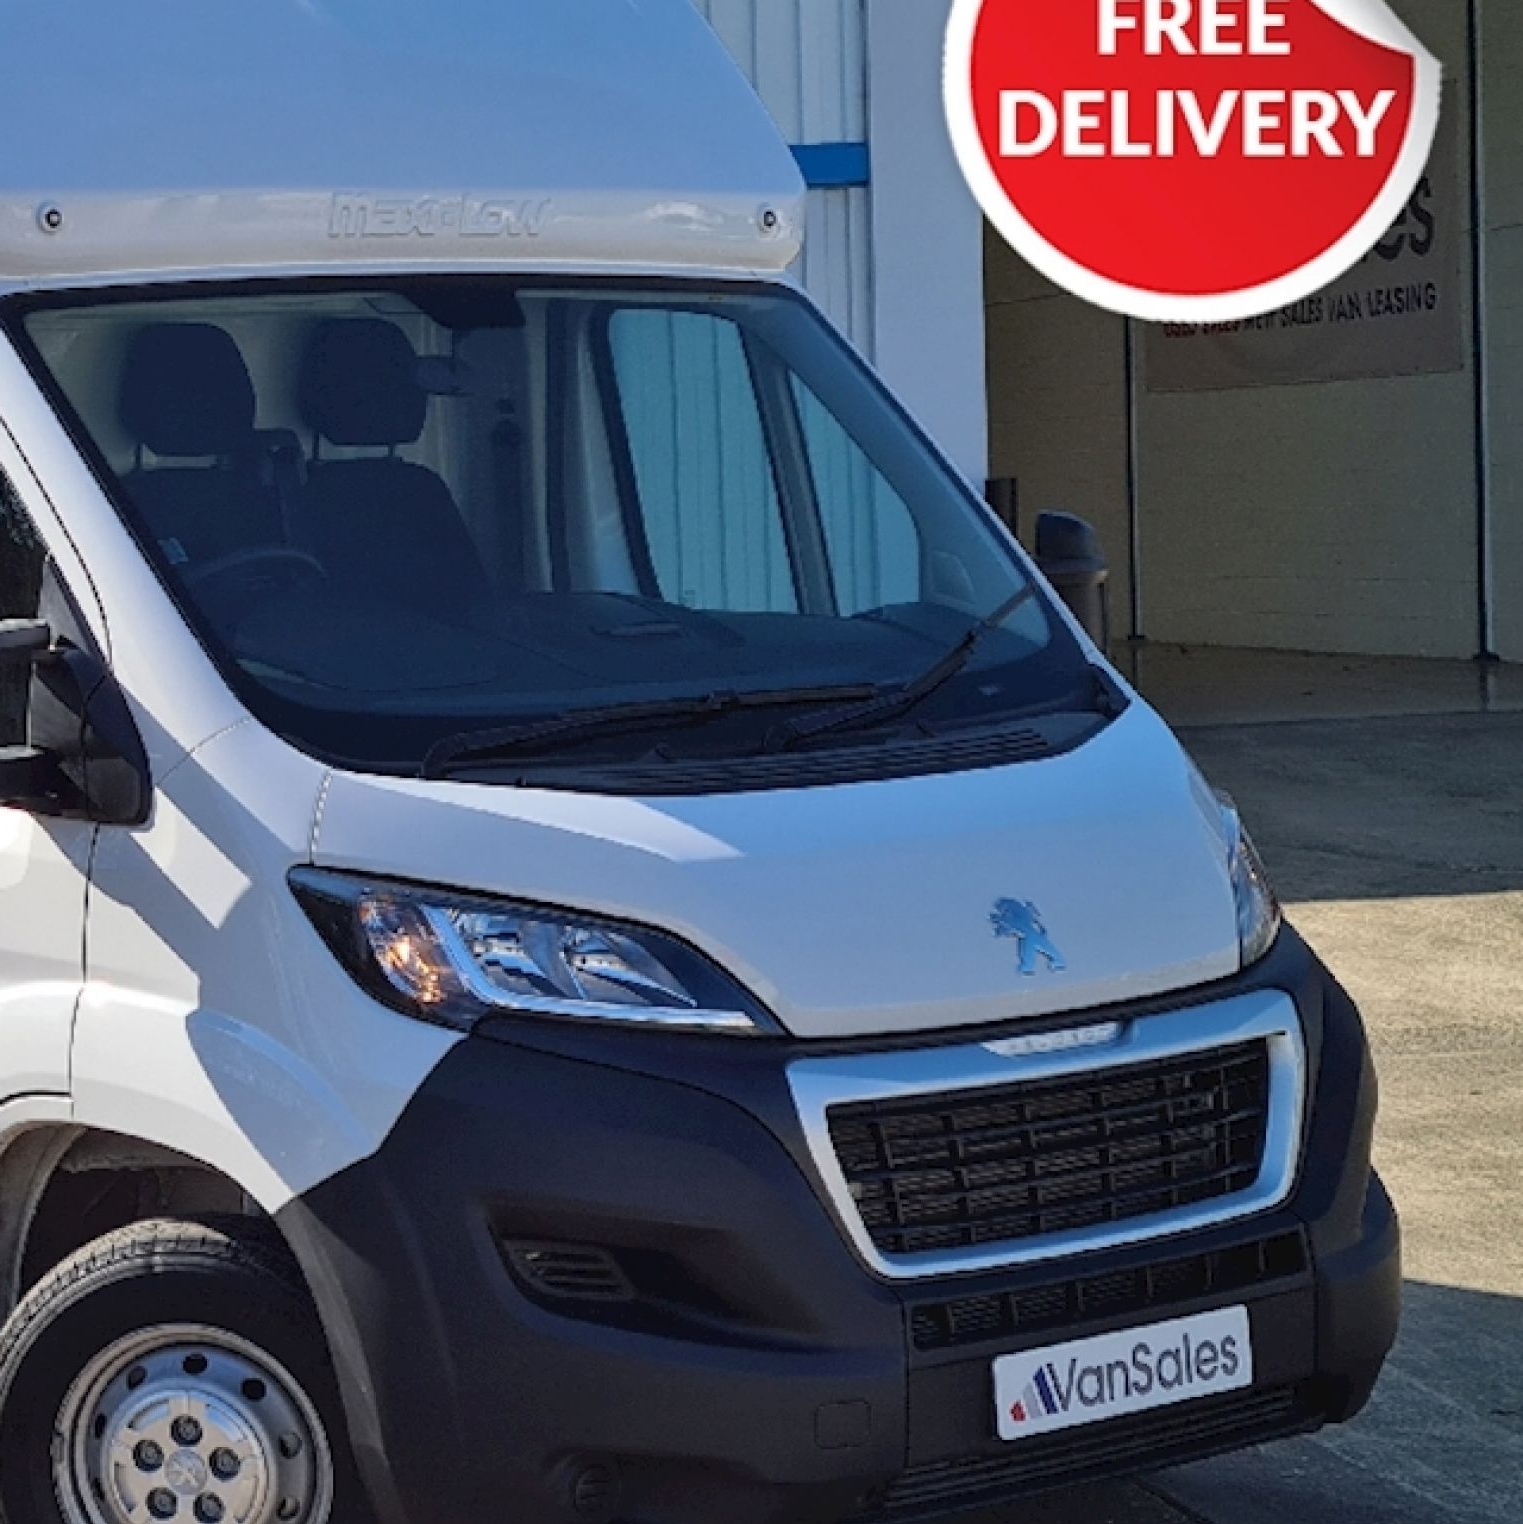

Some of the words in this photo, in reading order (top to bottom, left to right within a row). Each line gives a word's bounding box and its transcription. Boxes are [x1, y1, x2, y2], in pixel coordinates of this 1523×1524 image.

[1328, 292, 1362, 322] VAN
[1367, 282, 1437, 317] LEASING
[1046, 1332, 1238, 1412] VanSales
